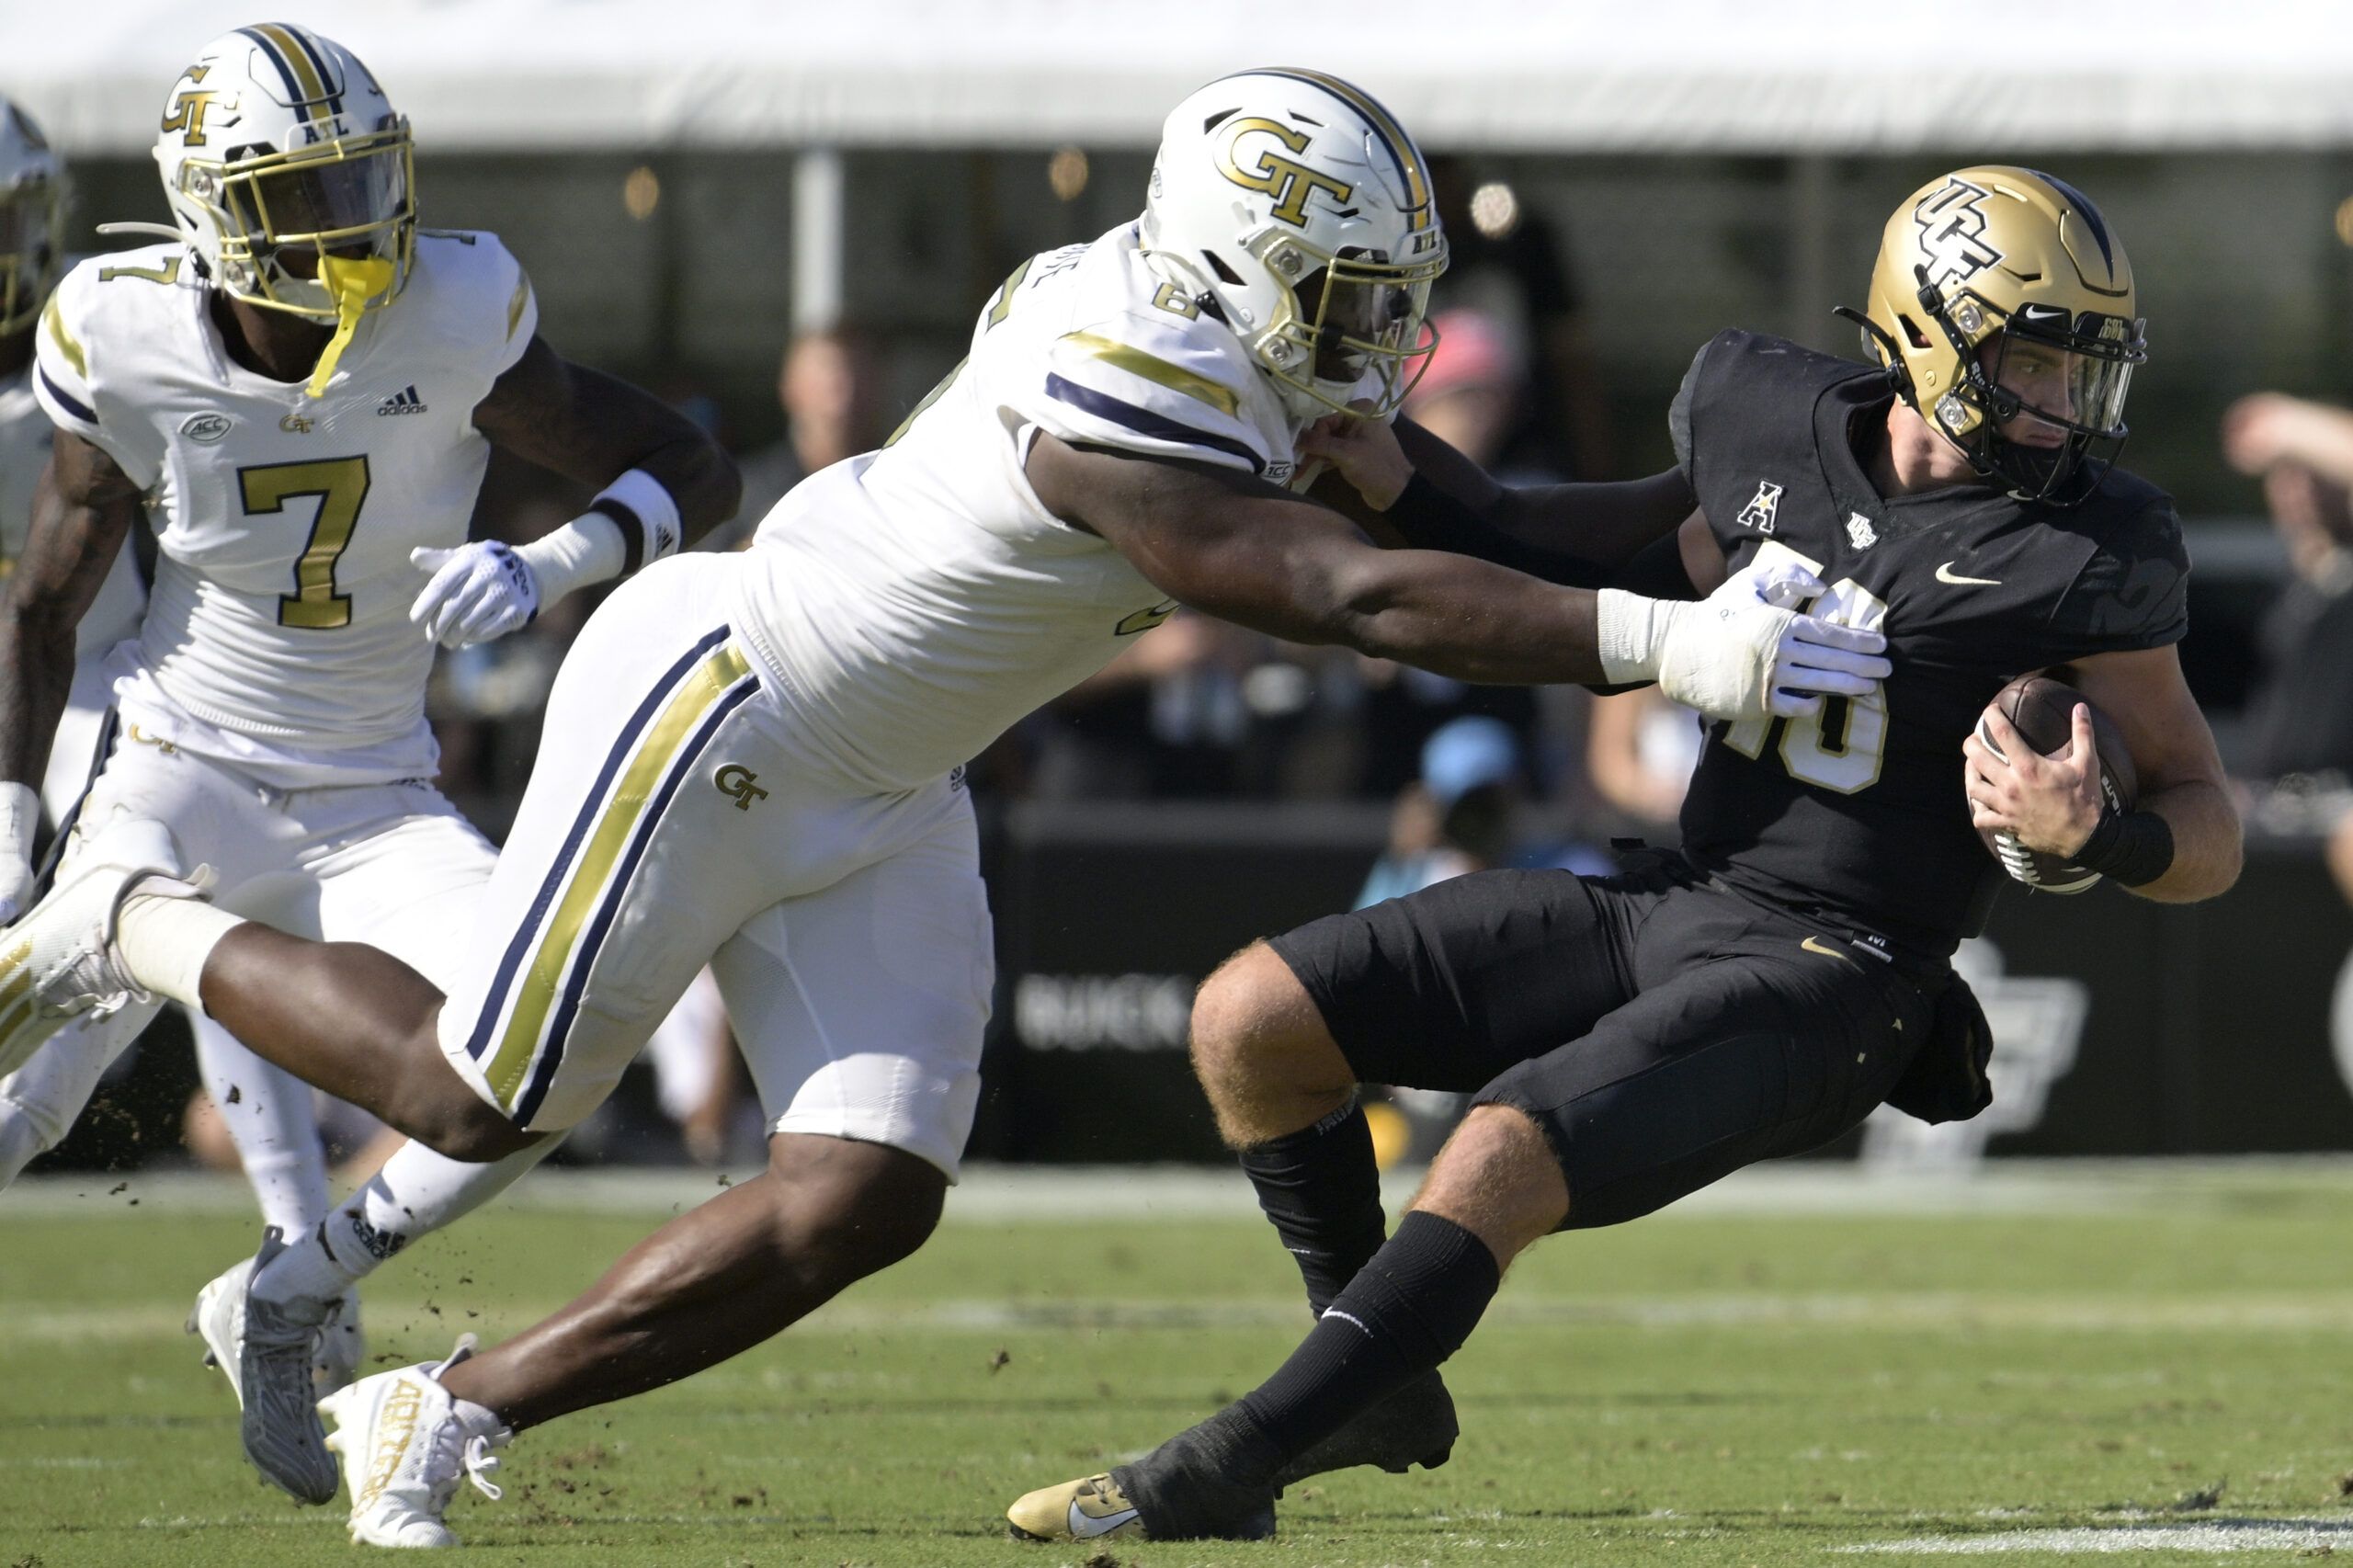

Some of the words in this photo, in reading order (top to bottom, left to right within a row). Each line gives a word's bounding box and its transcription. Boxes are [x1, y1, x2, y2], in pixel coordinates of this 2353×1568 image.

[162, 65, 241, 146] GT
[302, 118, 349, 144] ATL
[1212, 117, 1354, 228] GT
[1914, 175, 2006, 290] UCF
[190, 417, 224, 434] ACC
[377, 403, 427, 416] adidas
[236, 453, 370, 630] 7
[714, 764, 768, 811] GT
